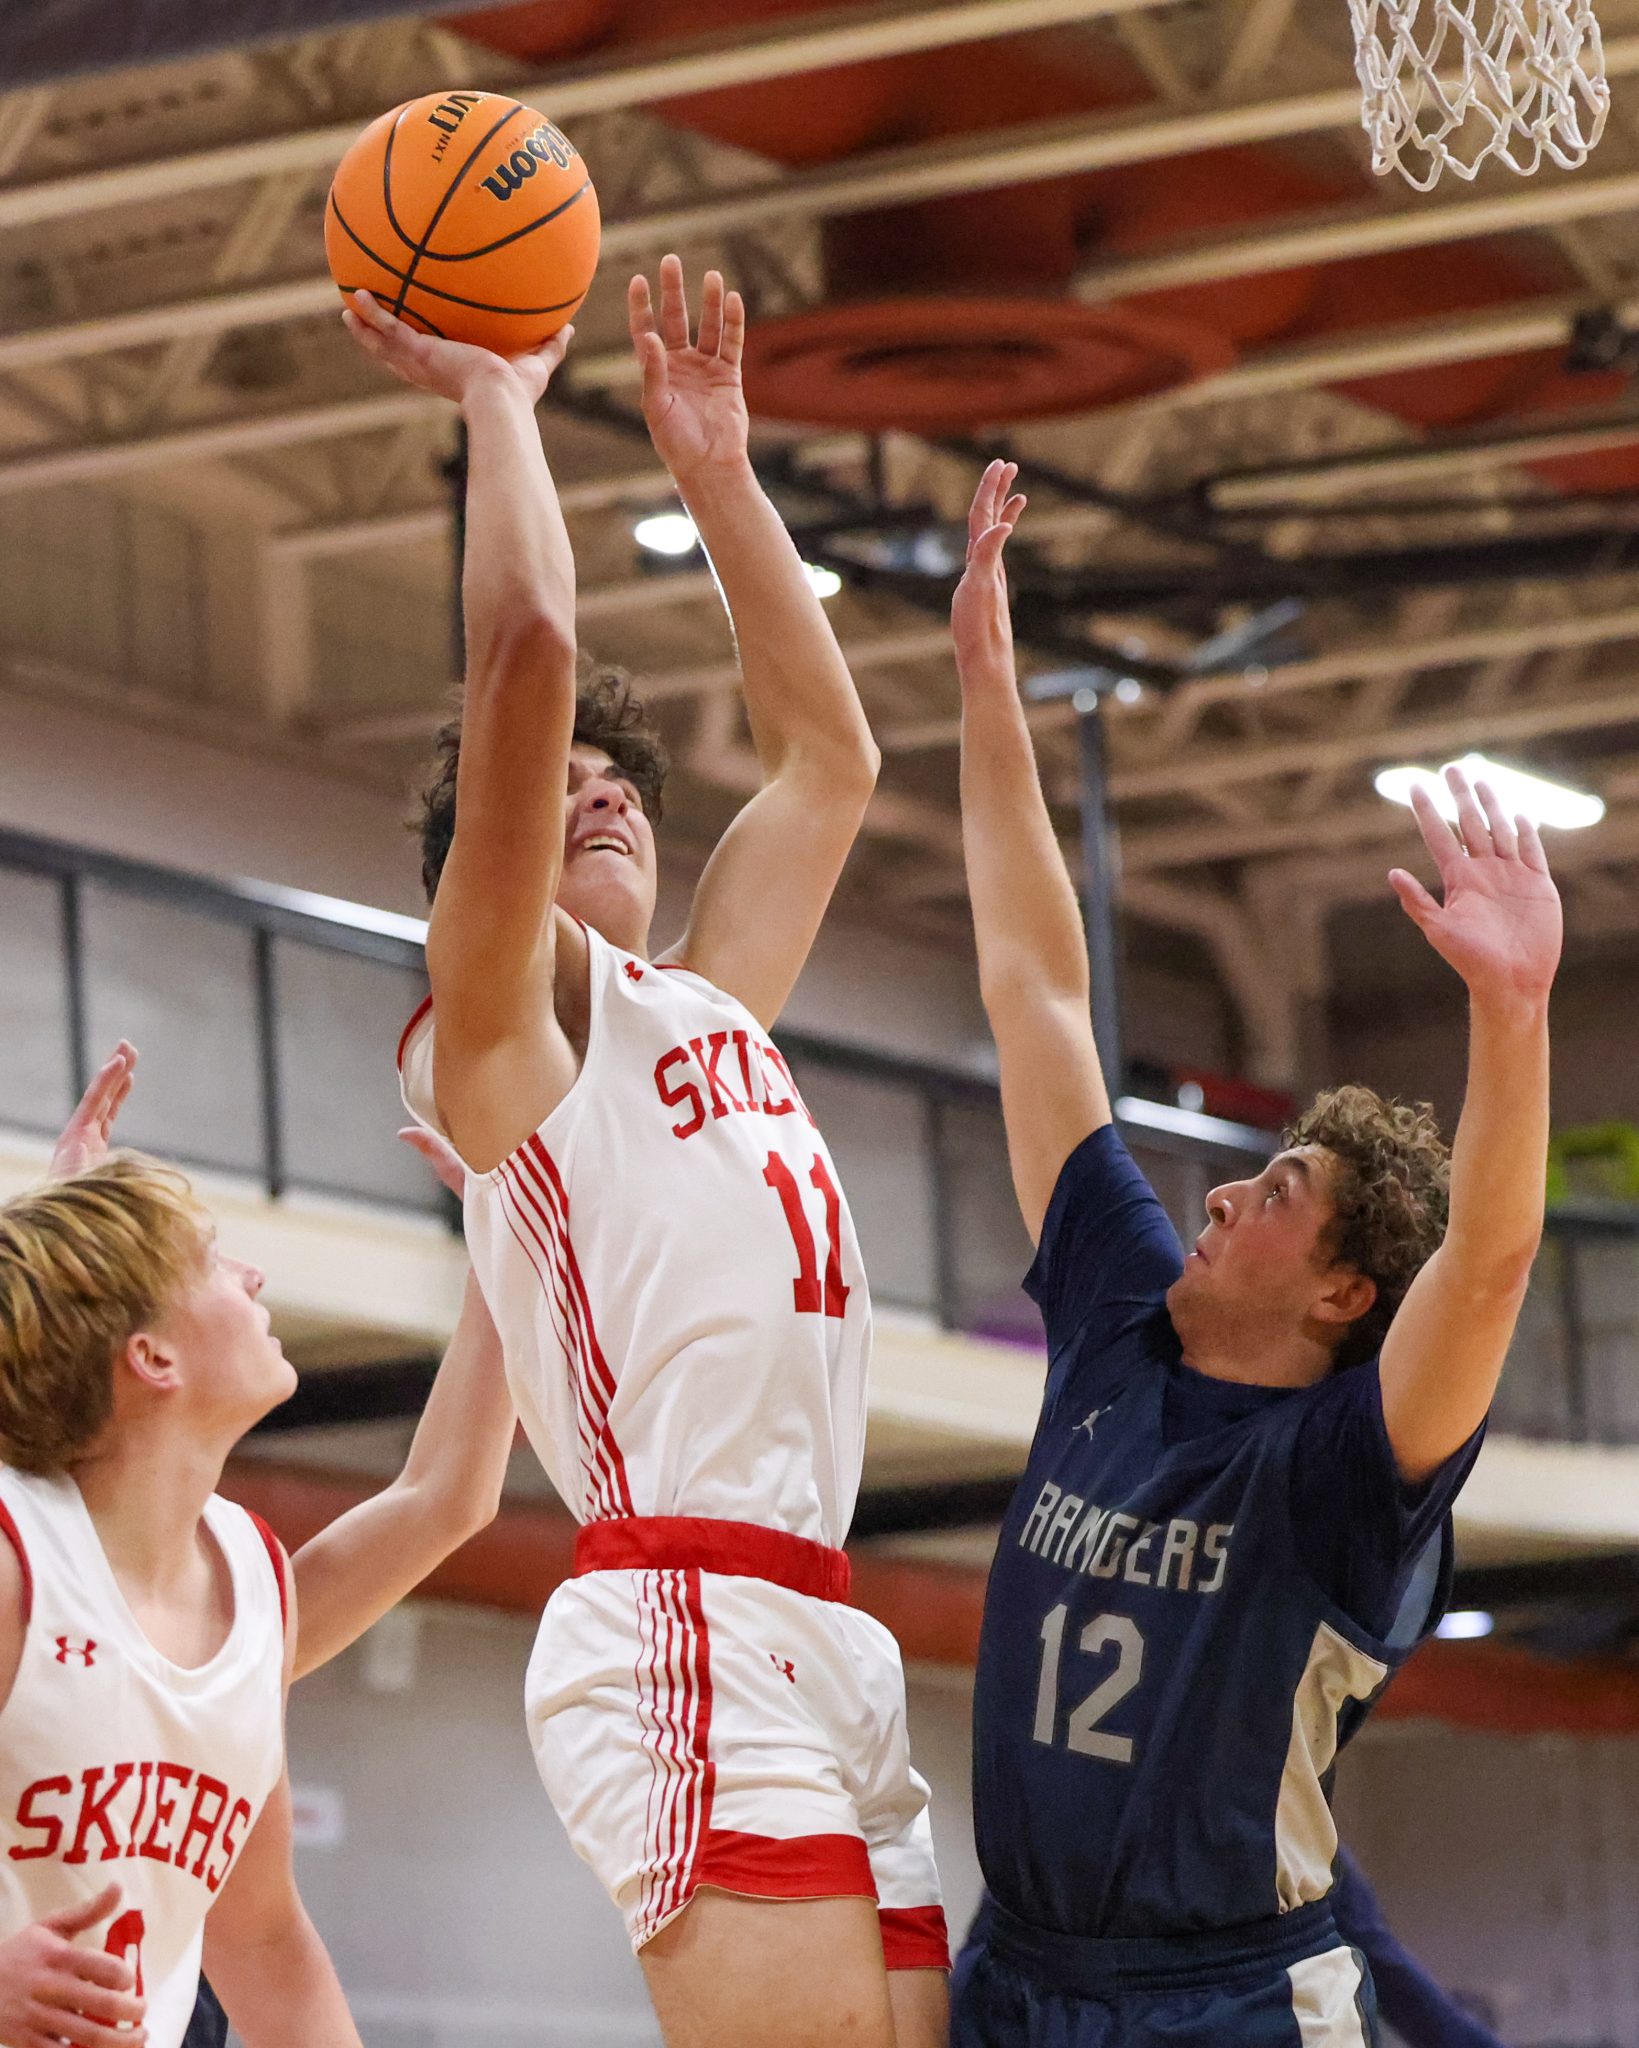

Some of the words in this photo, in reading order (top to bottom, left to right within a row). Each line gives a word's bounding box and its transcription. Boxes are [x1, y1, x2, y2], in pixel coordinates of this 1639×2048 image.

[431, 133, 451, 164] NXT
[481, 121, 578, 201] ilson
[762, 1150, 850, 1319] 11
[1019, 1480, 1235, 1593] RANGERS
[1033, 1603, 1144, 1762] 12
[8, 1761, 251, 1893] SKIERS
